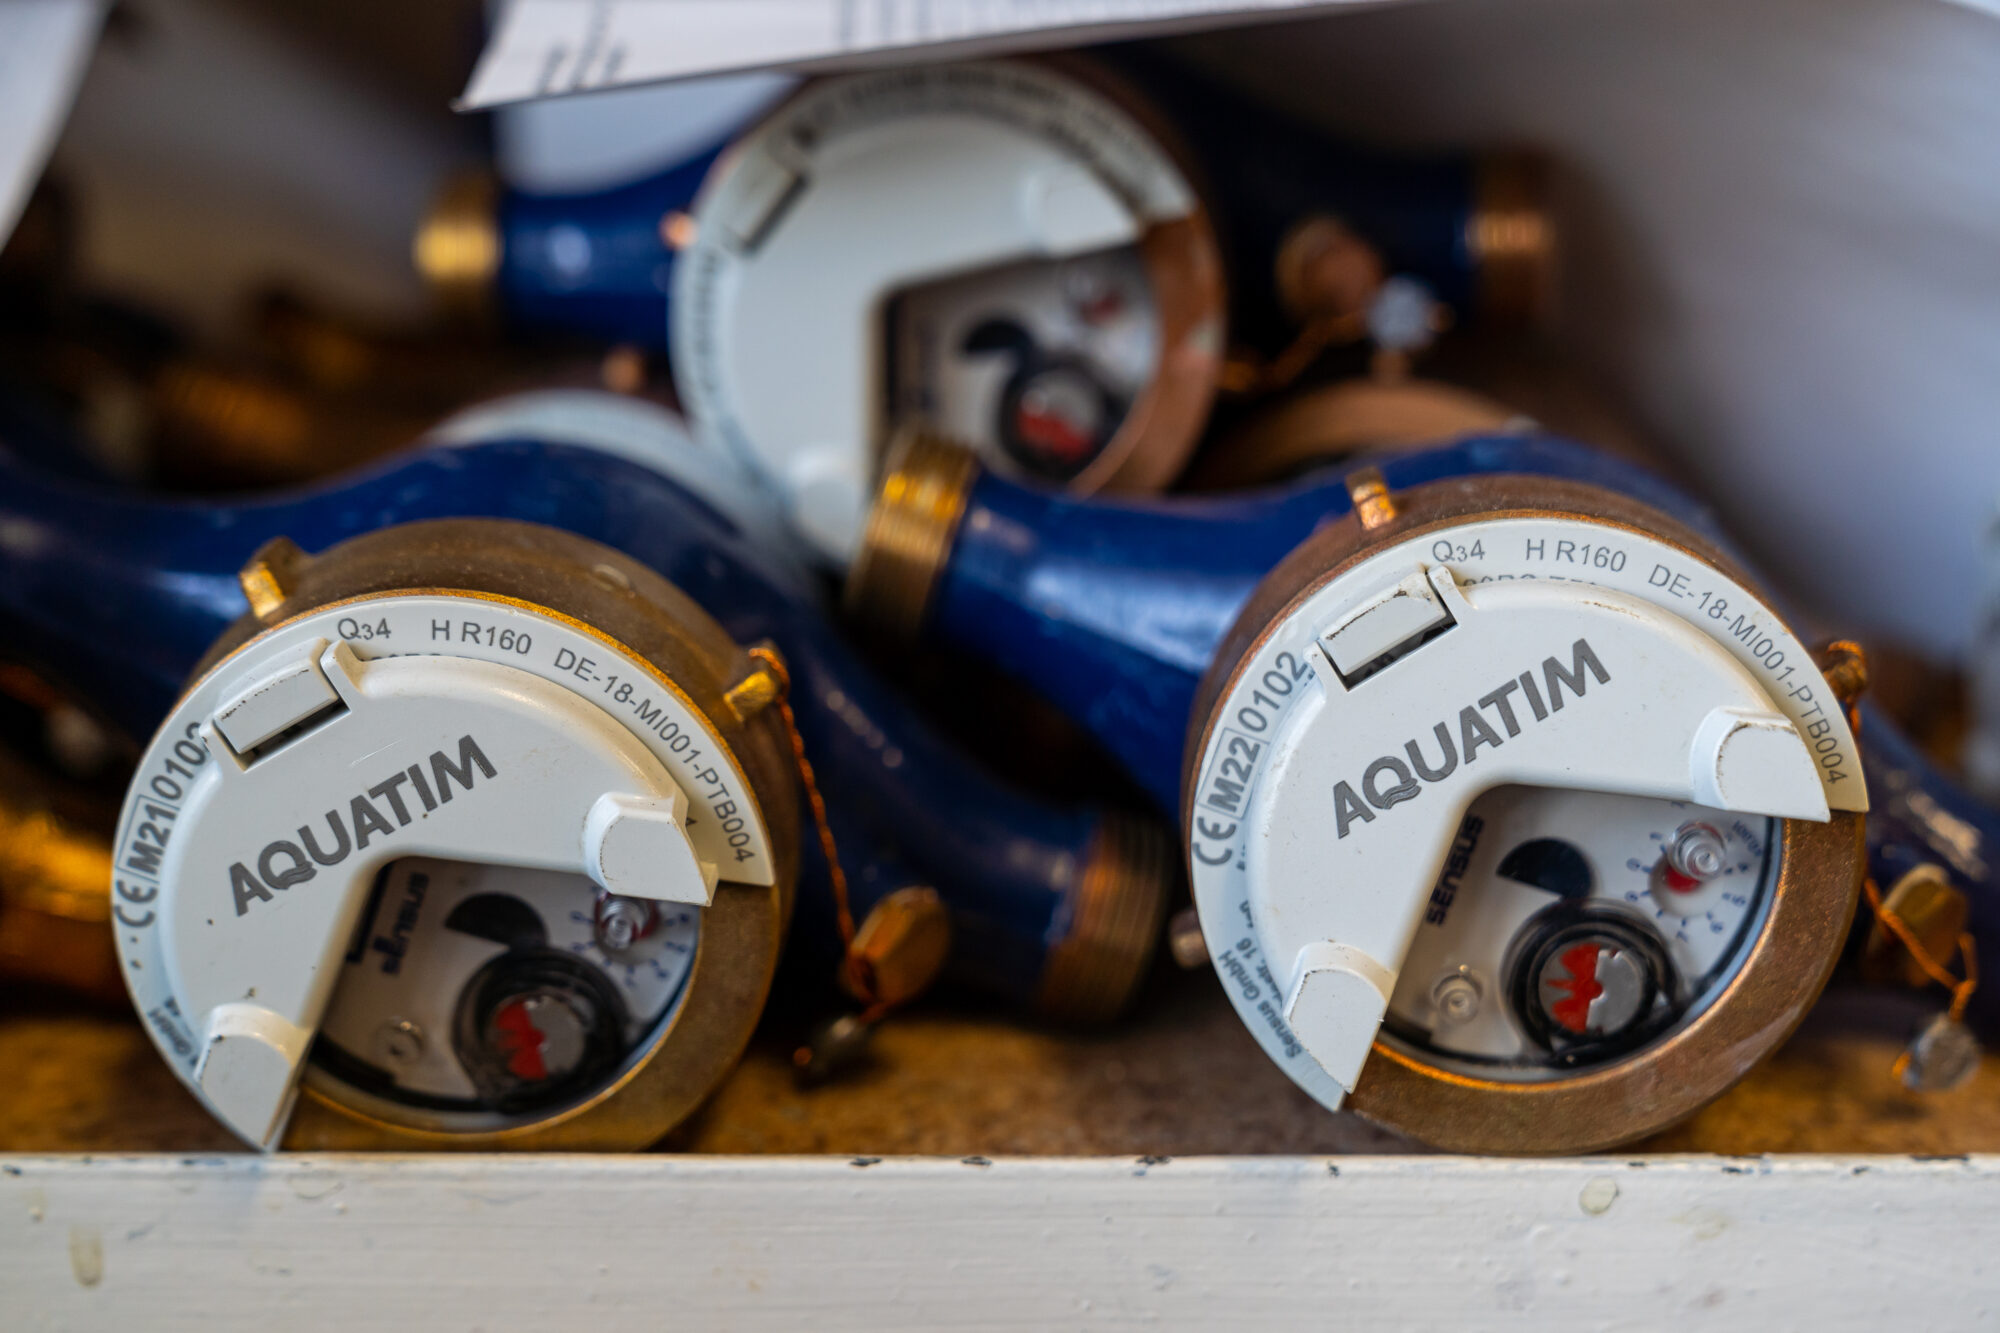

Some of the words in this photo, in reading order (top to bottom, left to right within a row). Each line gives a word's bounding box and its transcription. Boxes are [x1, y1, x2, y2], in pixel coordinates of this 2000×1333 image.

[431, 619, 450, 641] H
[461, 621, 532, 655] R160
[553, 647, 755, 863] DE-18-MI001-PTB004
[1207, 736, 1261, 813] M22
[1237, 650, 1308, 734] 0102
[1332, 638, 1611, 840] AQUATIM
[1525, 538, 1545, 561] H
[1555, 540, 1627, 572] R160
[1648, 564, 1848, 785] DE-18-MI001-PTB004
[126, 801, 177, 876] M21
[229, 734, 498, 917] AQUATIM
[1218, 949, 1261, 1001] GmbH
[1257, 1000, 1303, 1059] Sensus
